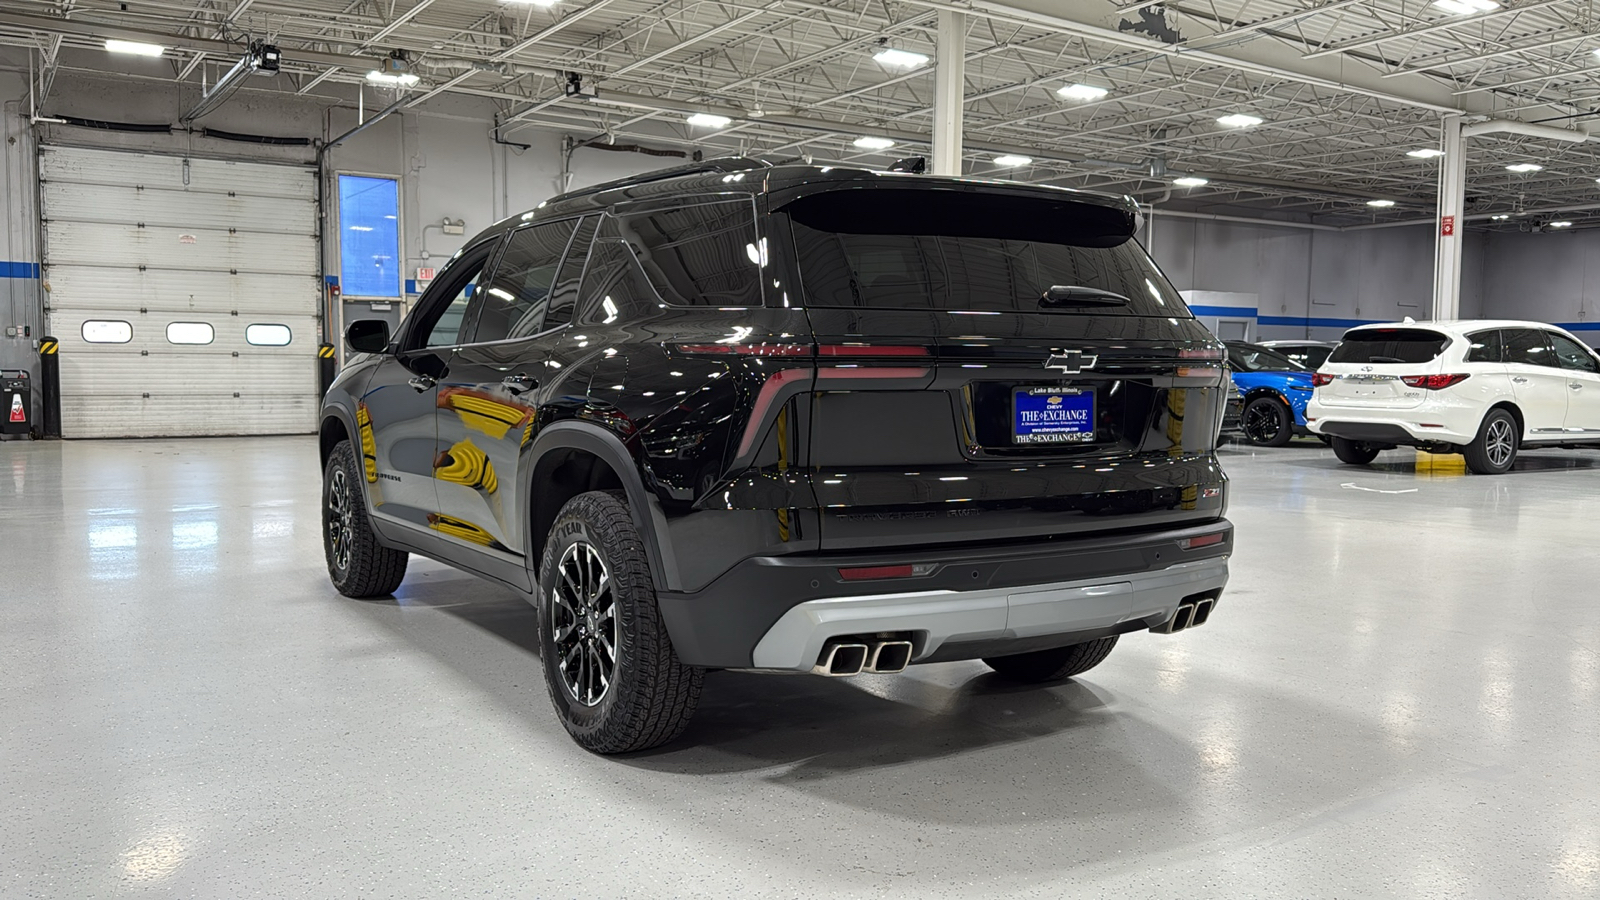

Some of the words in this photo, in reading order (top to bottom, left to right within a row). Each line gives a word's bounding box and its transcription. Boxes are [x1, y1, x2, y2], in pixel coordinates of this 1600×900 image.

[420, 268, 434, 279] EXIT
[1021, 410, 1040, 422] THE
[1043, 409, 1088, 421] EXCHANGE
[1016, 435, 1031, 443] THE
[1037, 433, 1079, 443] EXCHANGE
